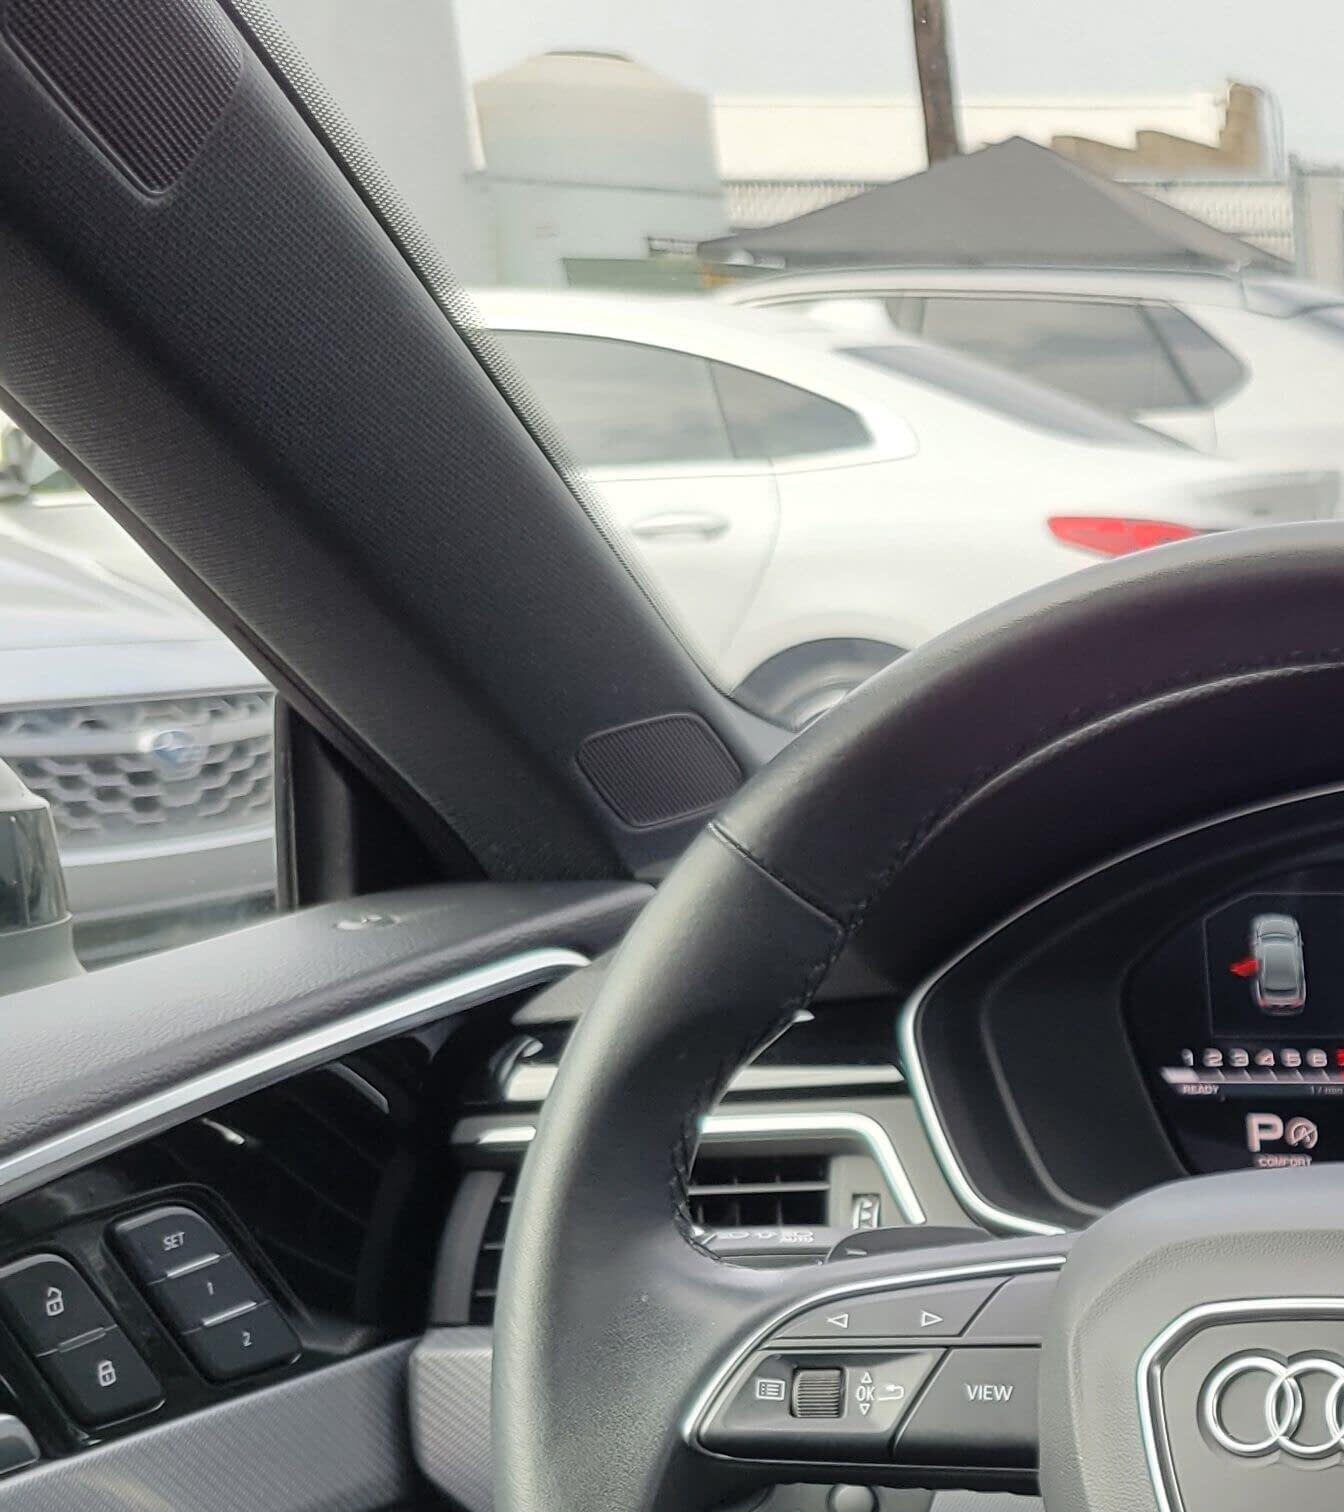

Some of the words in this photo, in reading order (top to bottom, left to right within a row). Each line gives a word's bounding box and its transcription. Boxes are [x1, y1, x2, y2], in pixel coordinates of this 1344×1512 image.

[1182, 1085, 1220, 1095] READY
[1246, 1112, 1284, 1152] P
[162, 1231, 185, 1251] SET
[855, 1385, 876, 1401] OK
[965, 1383, 1014, 1401] VIEW
